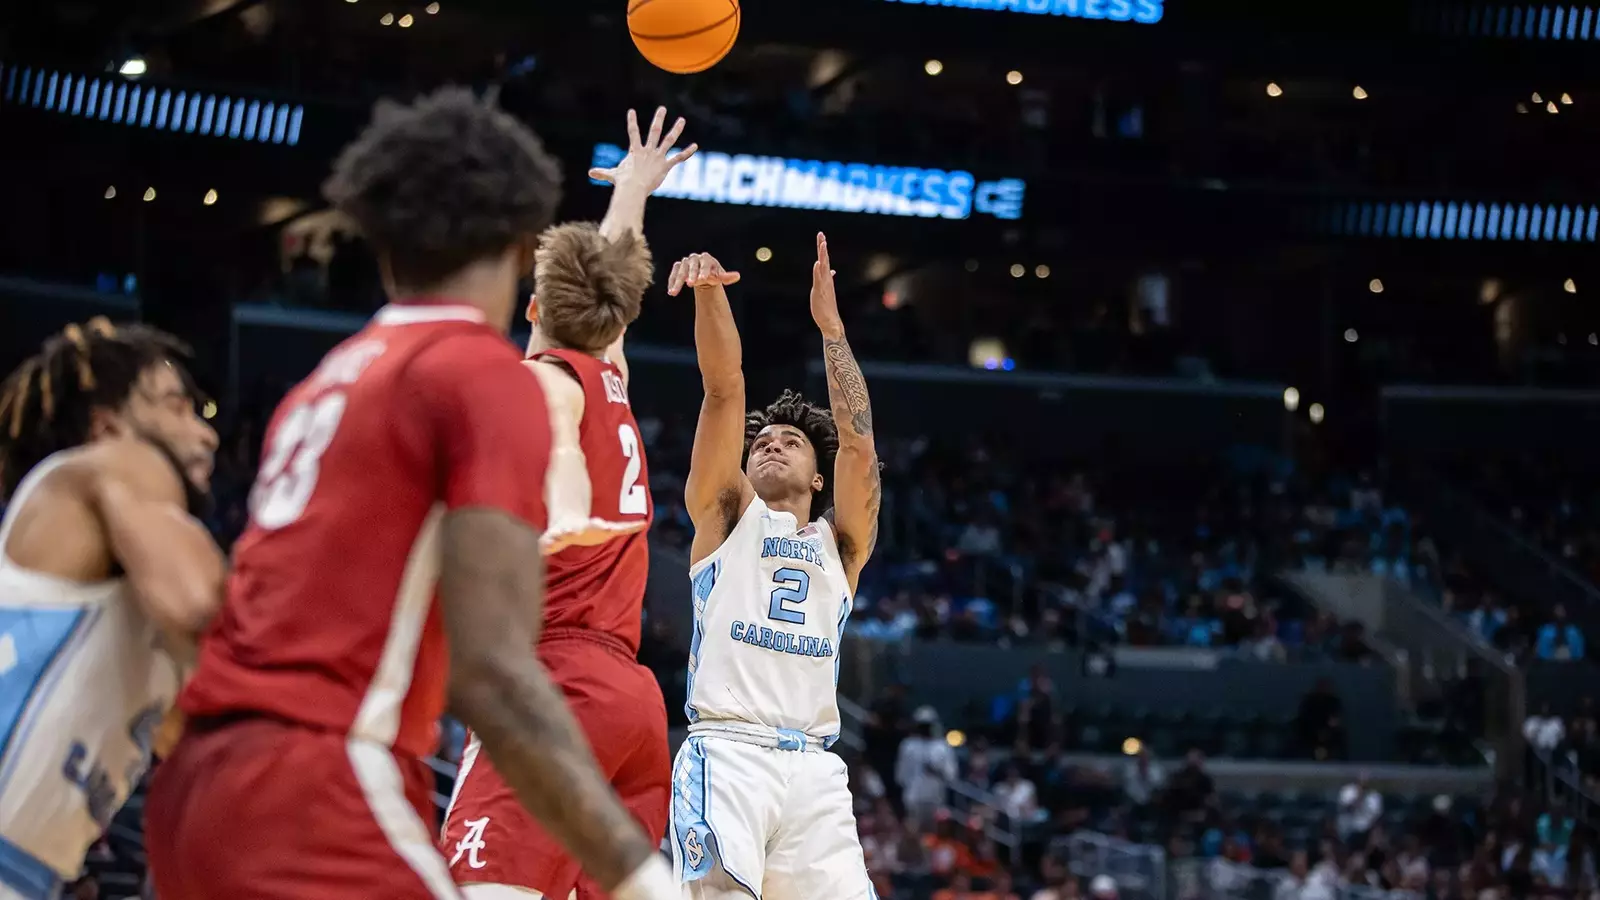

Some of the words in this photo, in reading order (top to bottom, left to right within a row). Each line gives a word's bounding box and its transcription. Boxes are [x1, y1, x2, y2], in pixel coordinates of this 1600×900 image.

[618, 424, 648, 515] 2
[768, 567, 810, 625] 2
[731, 620, 833, 658] CAROLINA
[449, 817, 490, 869] A
